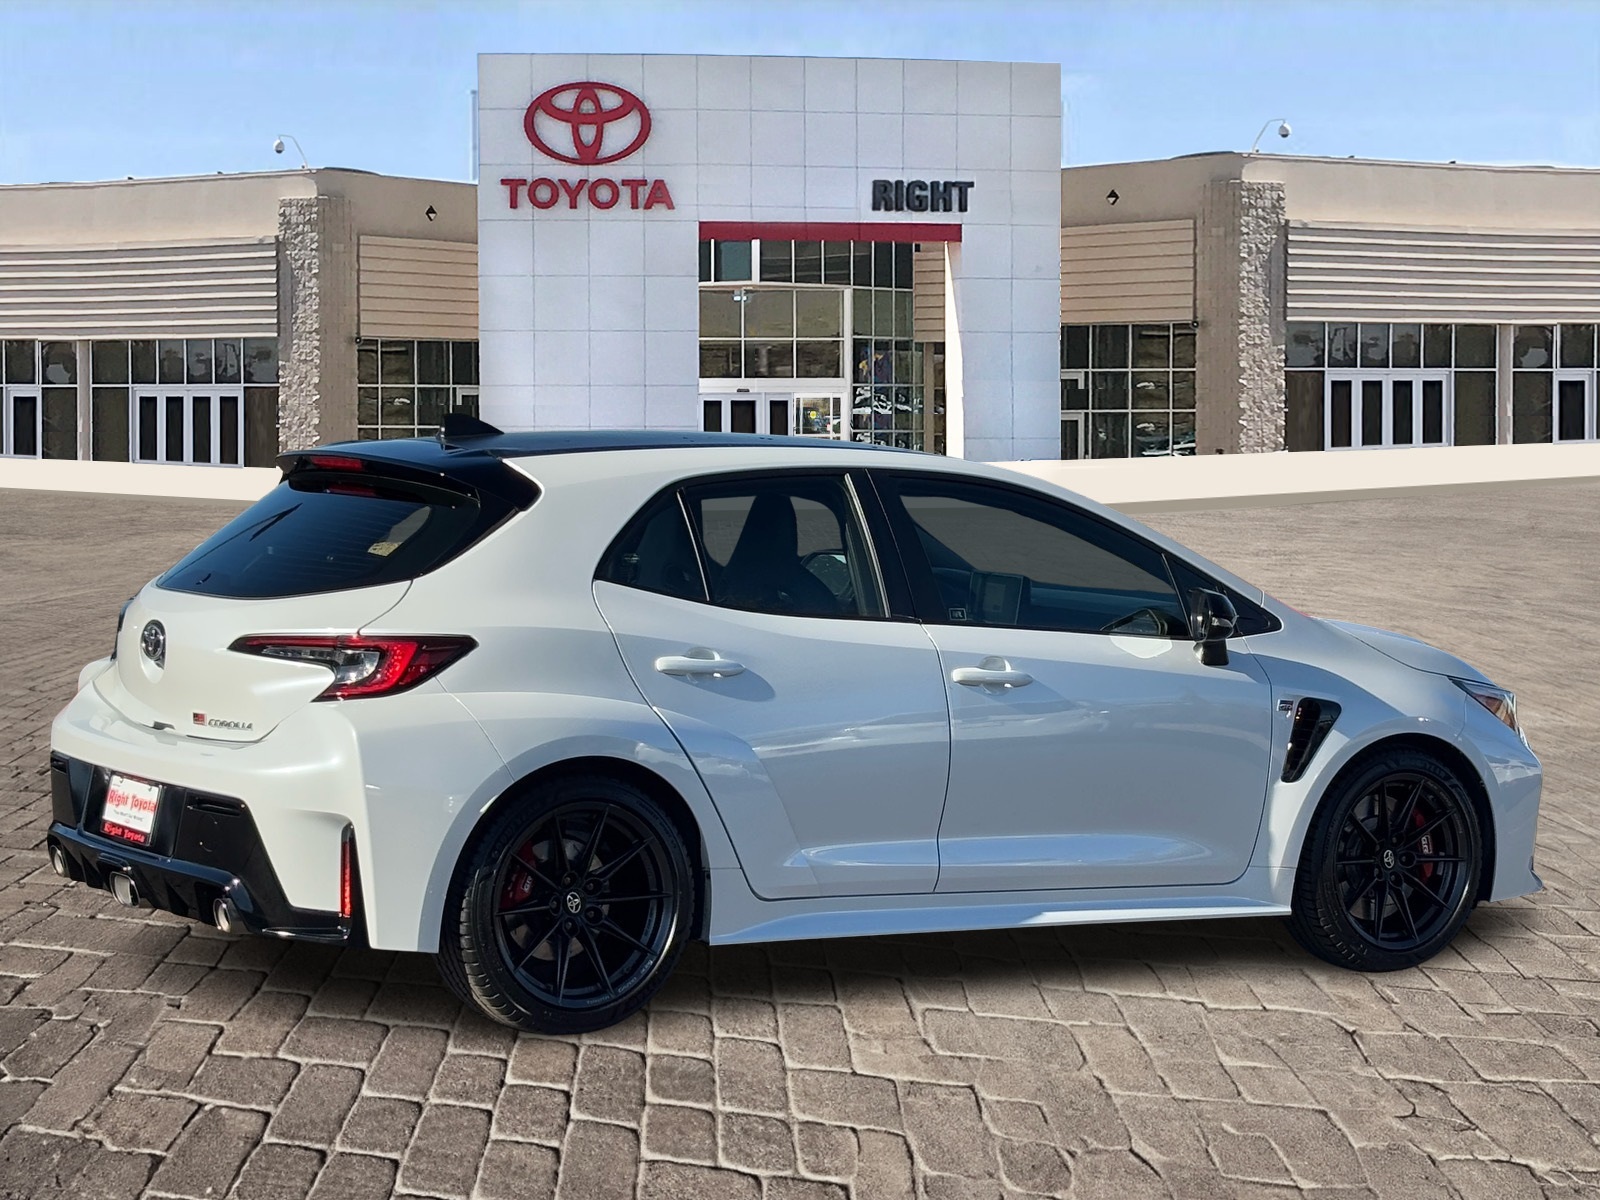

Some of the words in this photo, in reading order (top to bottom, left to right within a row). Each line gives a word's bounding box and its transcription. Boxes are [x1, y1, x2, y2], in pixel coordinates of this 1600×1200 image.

[500, 177, 676, 210] TOYOTA
[872, 179, 975, 213] RIGHT
[208, 718, 253, 730] COROLLA
[108, 789, 129, 808] Right
[130, 794, 157, 812] Toyota
